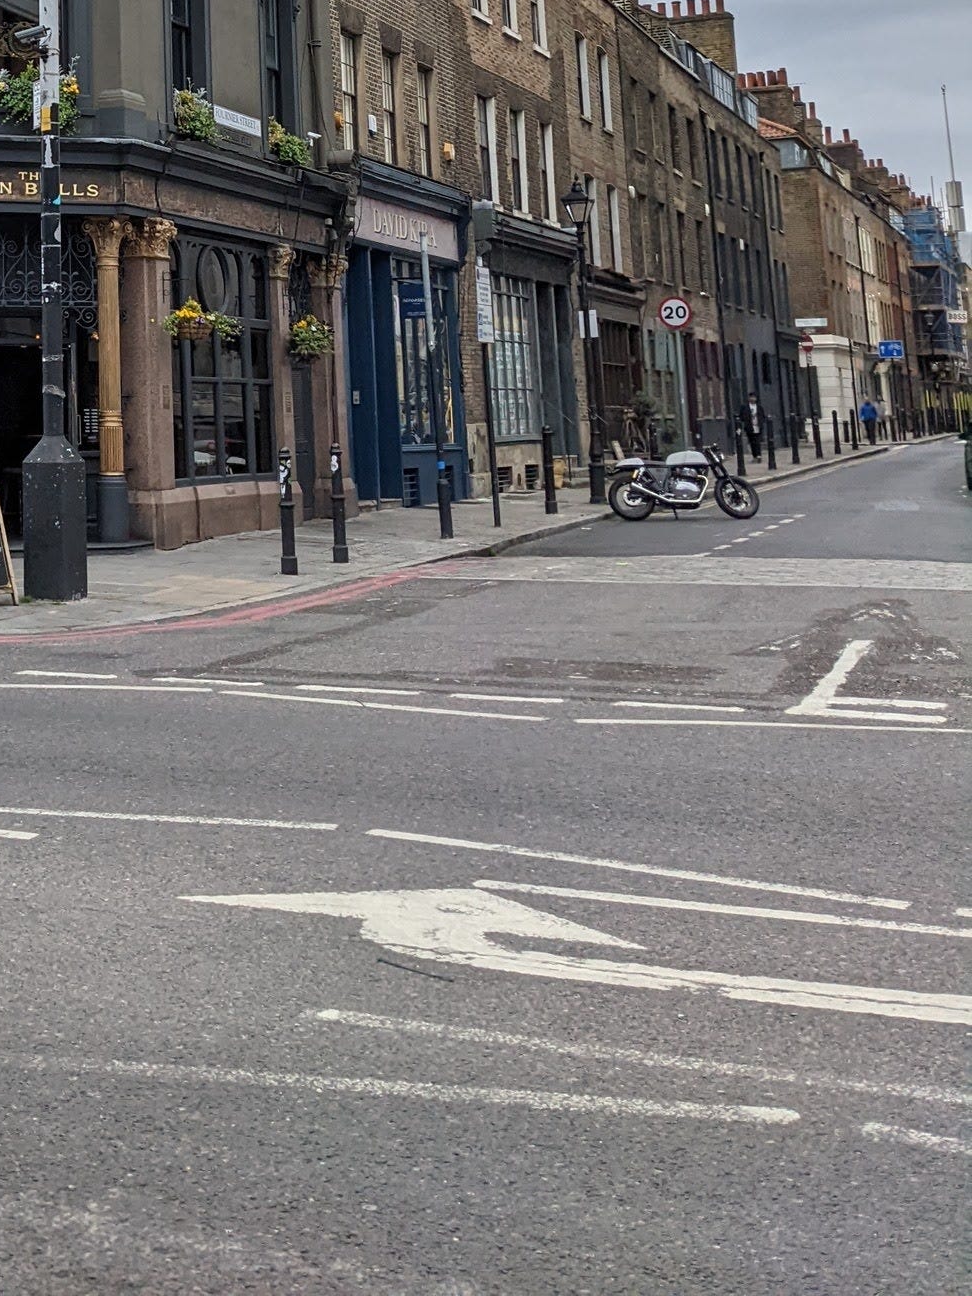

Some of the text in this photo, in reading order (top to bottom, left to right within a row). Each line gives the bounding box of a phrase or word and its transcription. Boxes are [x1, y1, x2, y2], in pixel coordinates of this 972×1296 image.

[239, 116, 256, 130] STREET
[18, 171, 42, 181] TH
[25, 181, 99, 197] BLLS
[373, 208, 408, 240] DAVID
[663, 305, 687, 319] 20
